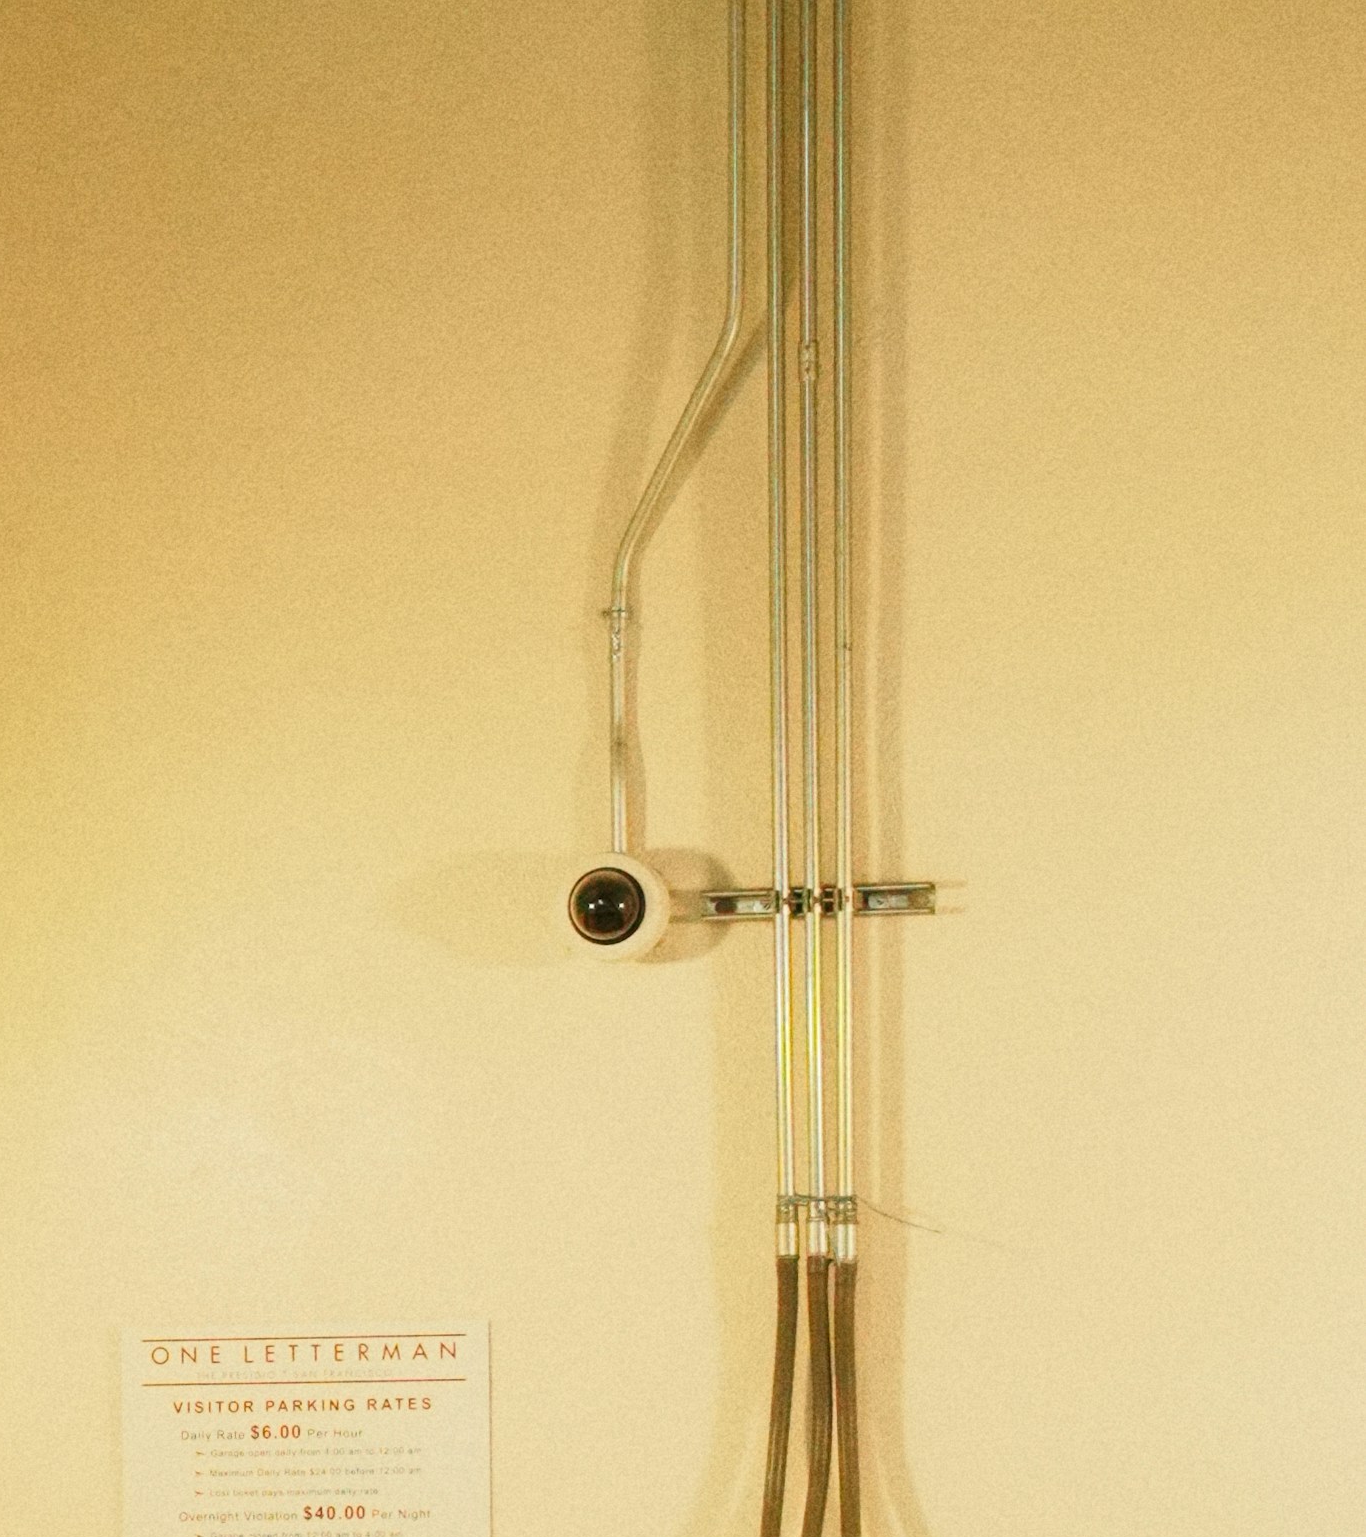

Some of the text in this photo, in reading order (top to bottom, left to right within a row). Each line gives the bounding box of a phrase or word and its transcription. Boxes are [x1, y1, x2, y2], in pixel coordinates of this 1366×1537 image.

[151, 1342, 456, 1364] ONE LETTERMAN
[174, 1397, 432, 1413] VISITOR PARKING RATES
[180, 1424, 363, 1443] Daily Rate $6.00 Per Hour
[178, 1505, 431, 1524] Overnight Violation $40.00 Per Night
